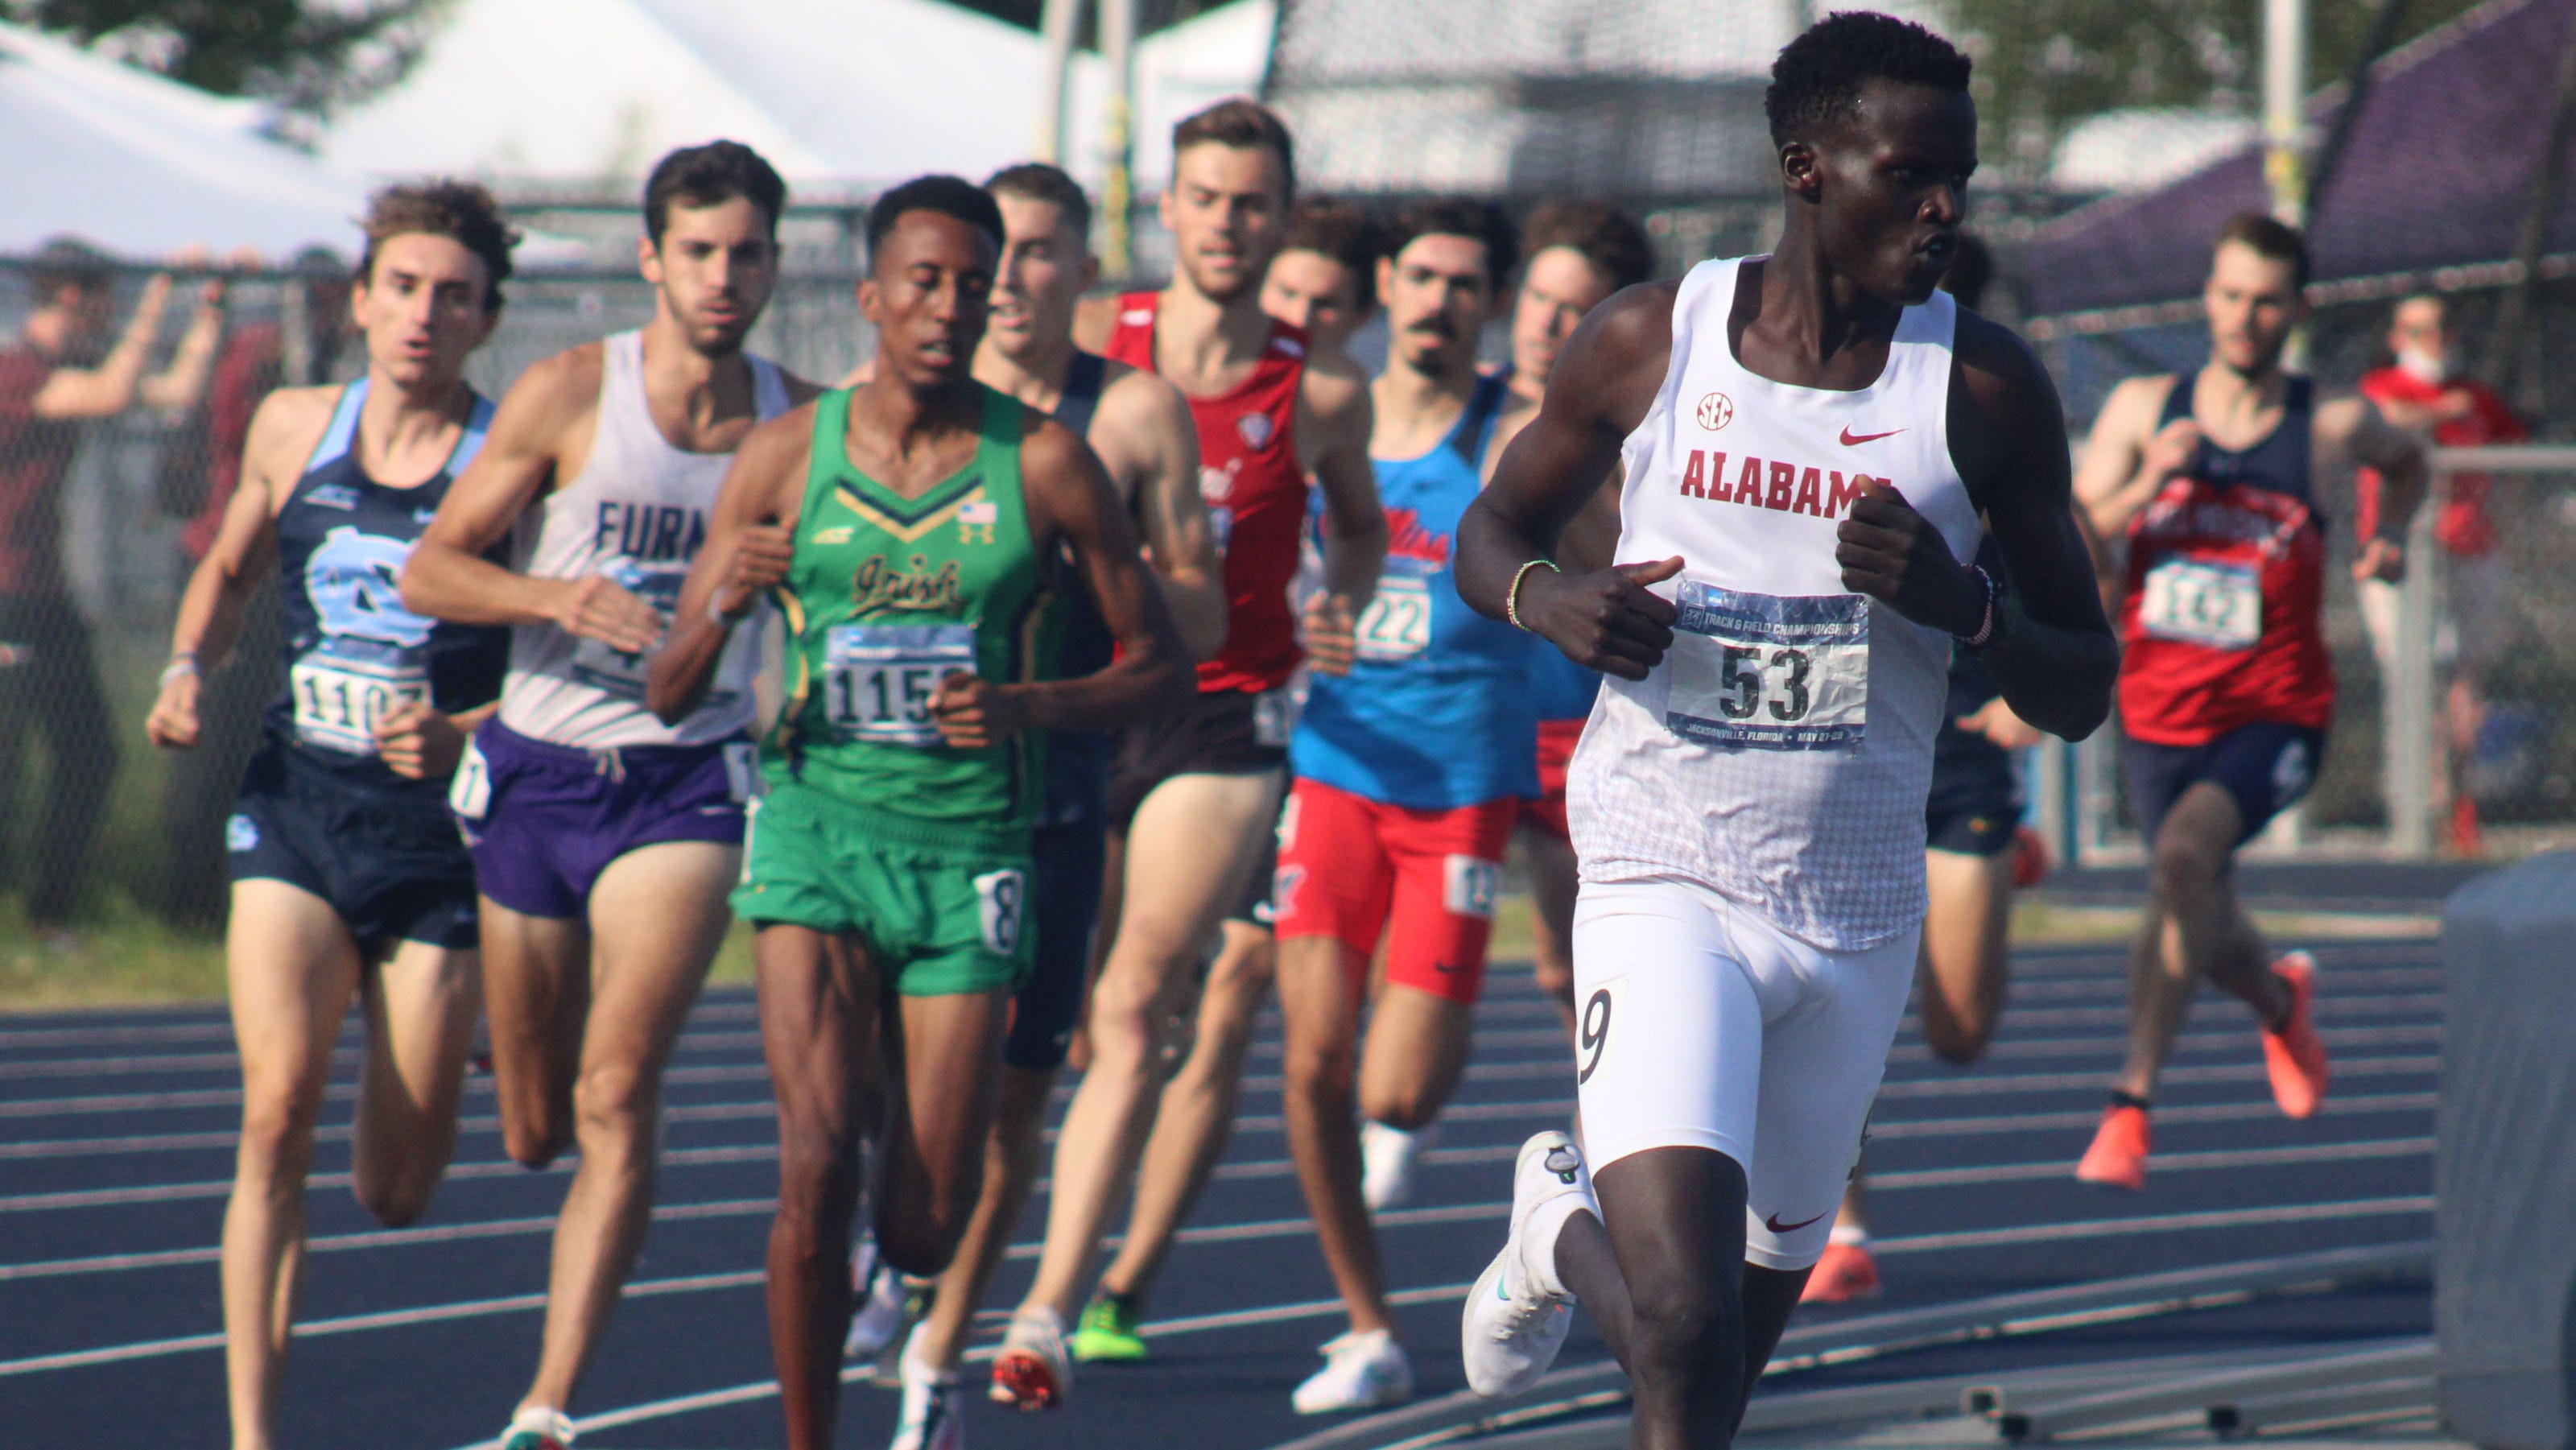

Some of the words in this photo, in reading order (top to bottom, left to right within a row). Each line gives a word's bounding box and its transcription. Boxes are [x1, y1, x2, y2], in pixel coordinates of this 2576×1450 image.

[1699, 393, 1732, 430] SEC
[1680, 449, 1891, 519] ALABAM
[852, 553, 962, 604] Irish
[1704, 612, 1734, 630] TRACK
[1743, 620, 1772, 634] FIELD
[1773, 622, 1860, 637] CHAMPIONSHIPS
[832, 666, 969, 723] 115
[1719, 646, 1809, 721] 53
[1686, 724, 1745, 741] JACKSONVILLE,
[1747, 731, 1784, 742] FLORIDA
[1797, 731, 1818, 742] MAY
[995, 878, 1016, 949] 8
[1579, 988, 1612, 1085] 9
